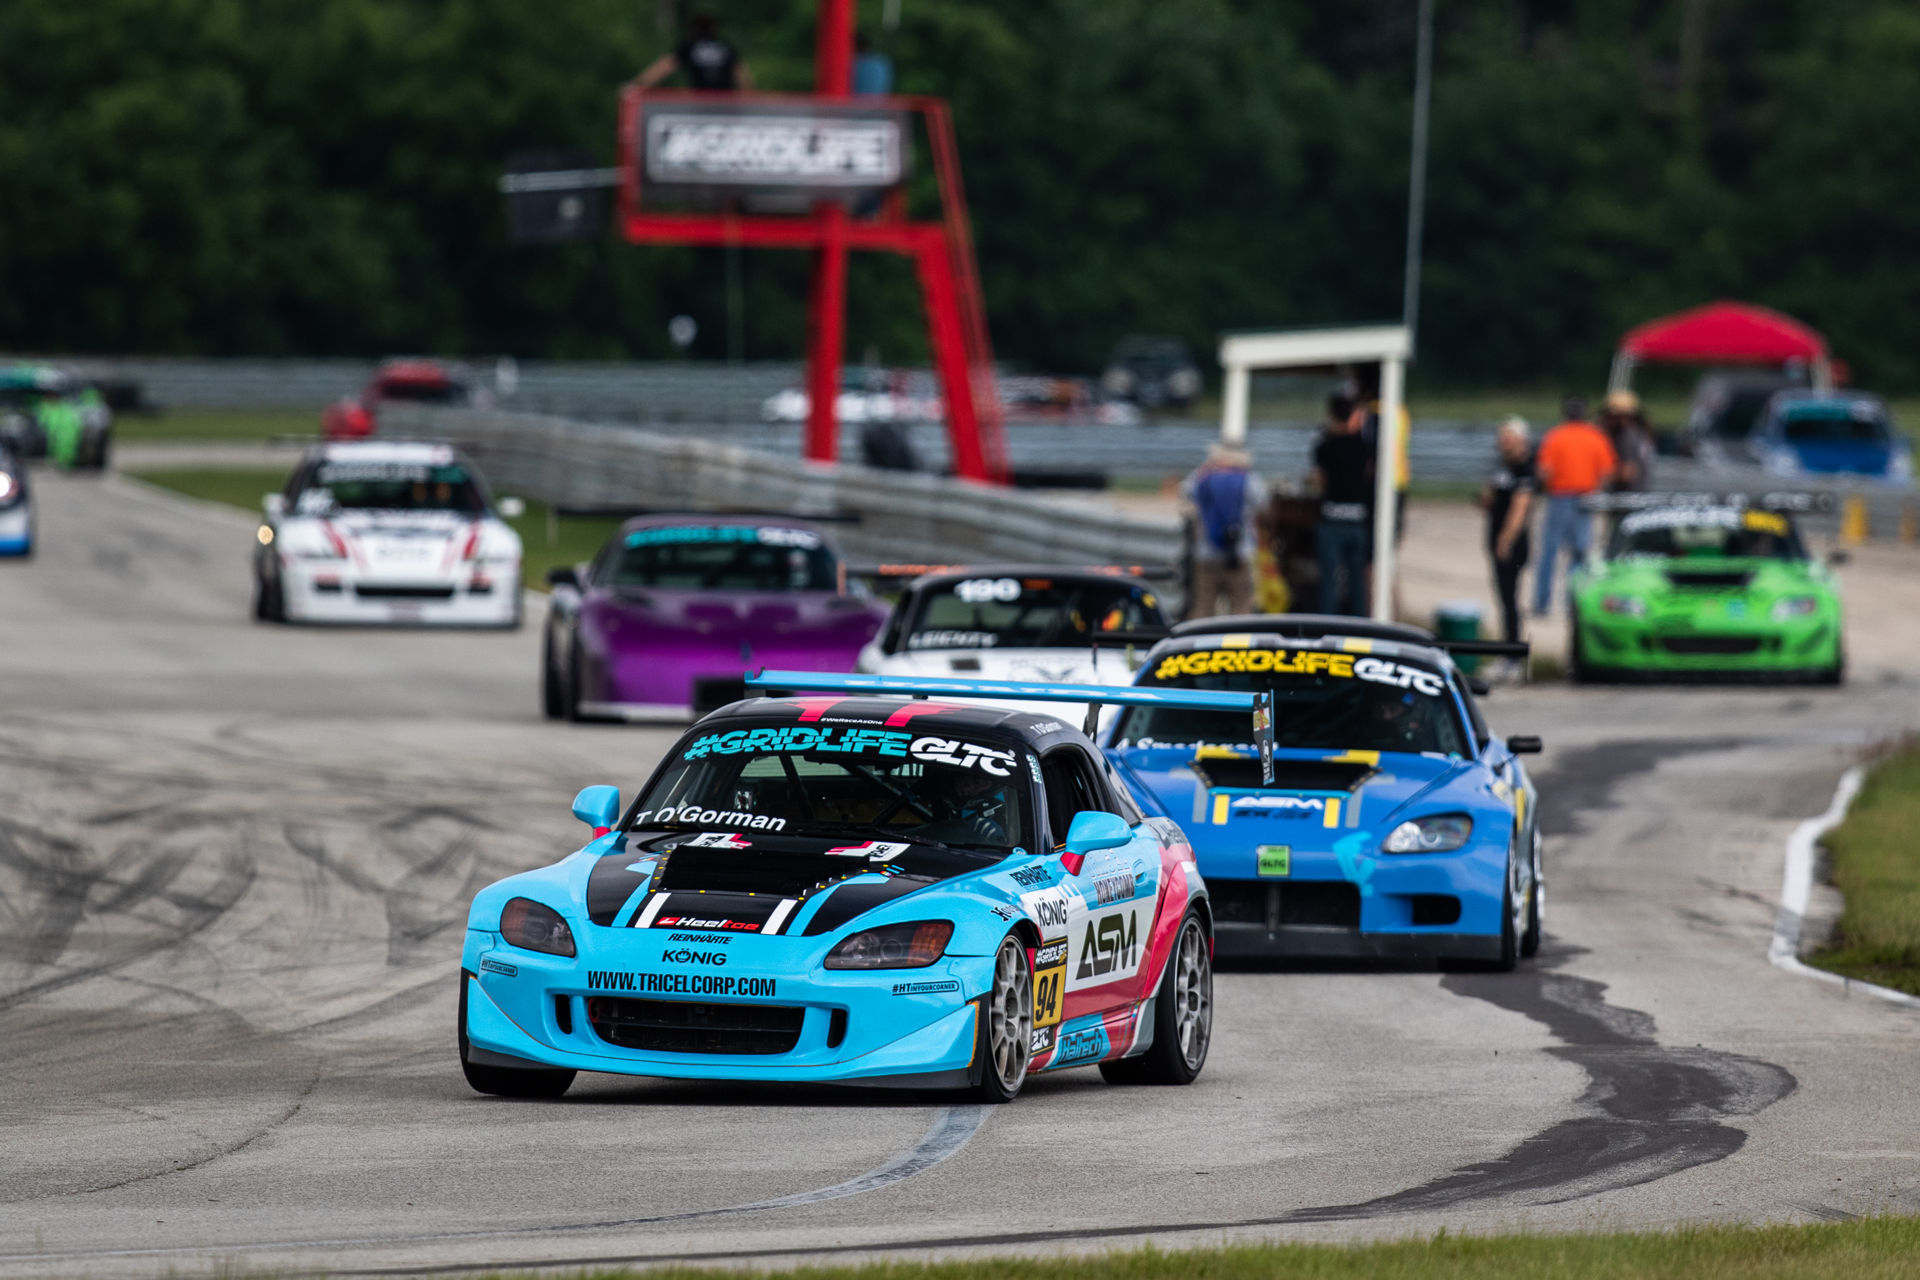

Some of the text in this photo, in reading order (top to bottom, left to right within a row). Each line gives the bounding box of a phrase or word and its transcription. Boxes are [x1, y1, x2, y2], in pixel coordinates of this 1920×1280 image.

[1155, 650, 1444, 696] #GRIDLIFE GLTC
[683, 727, 913, 760] #GRIDLIFE
[910, 736, 1018, 777] GLTC
[636, 806, 787, 831] T O'Gorman
[1034, 897, 1067, 926] KÖNIG
[668, 933, 733, 944] REINHÄRTE
[1075, 909, 1137, 980] ASM
[662, 948, 727, 966] KÖNIG
[587, 970, 777, 997] WWW.TRICELCORP.COM
[1035, 972, 1059, 1022] 94
